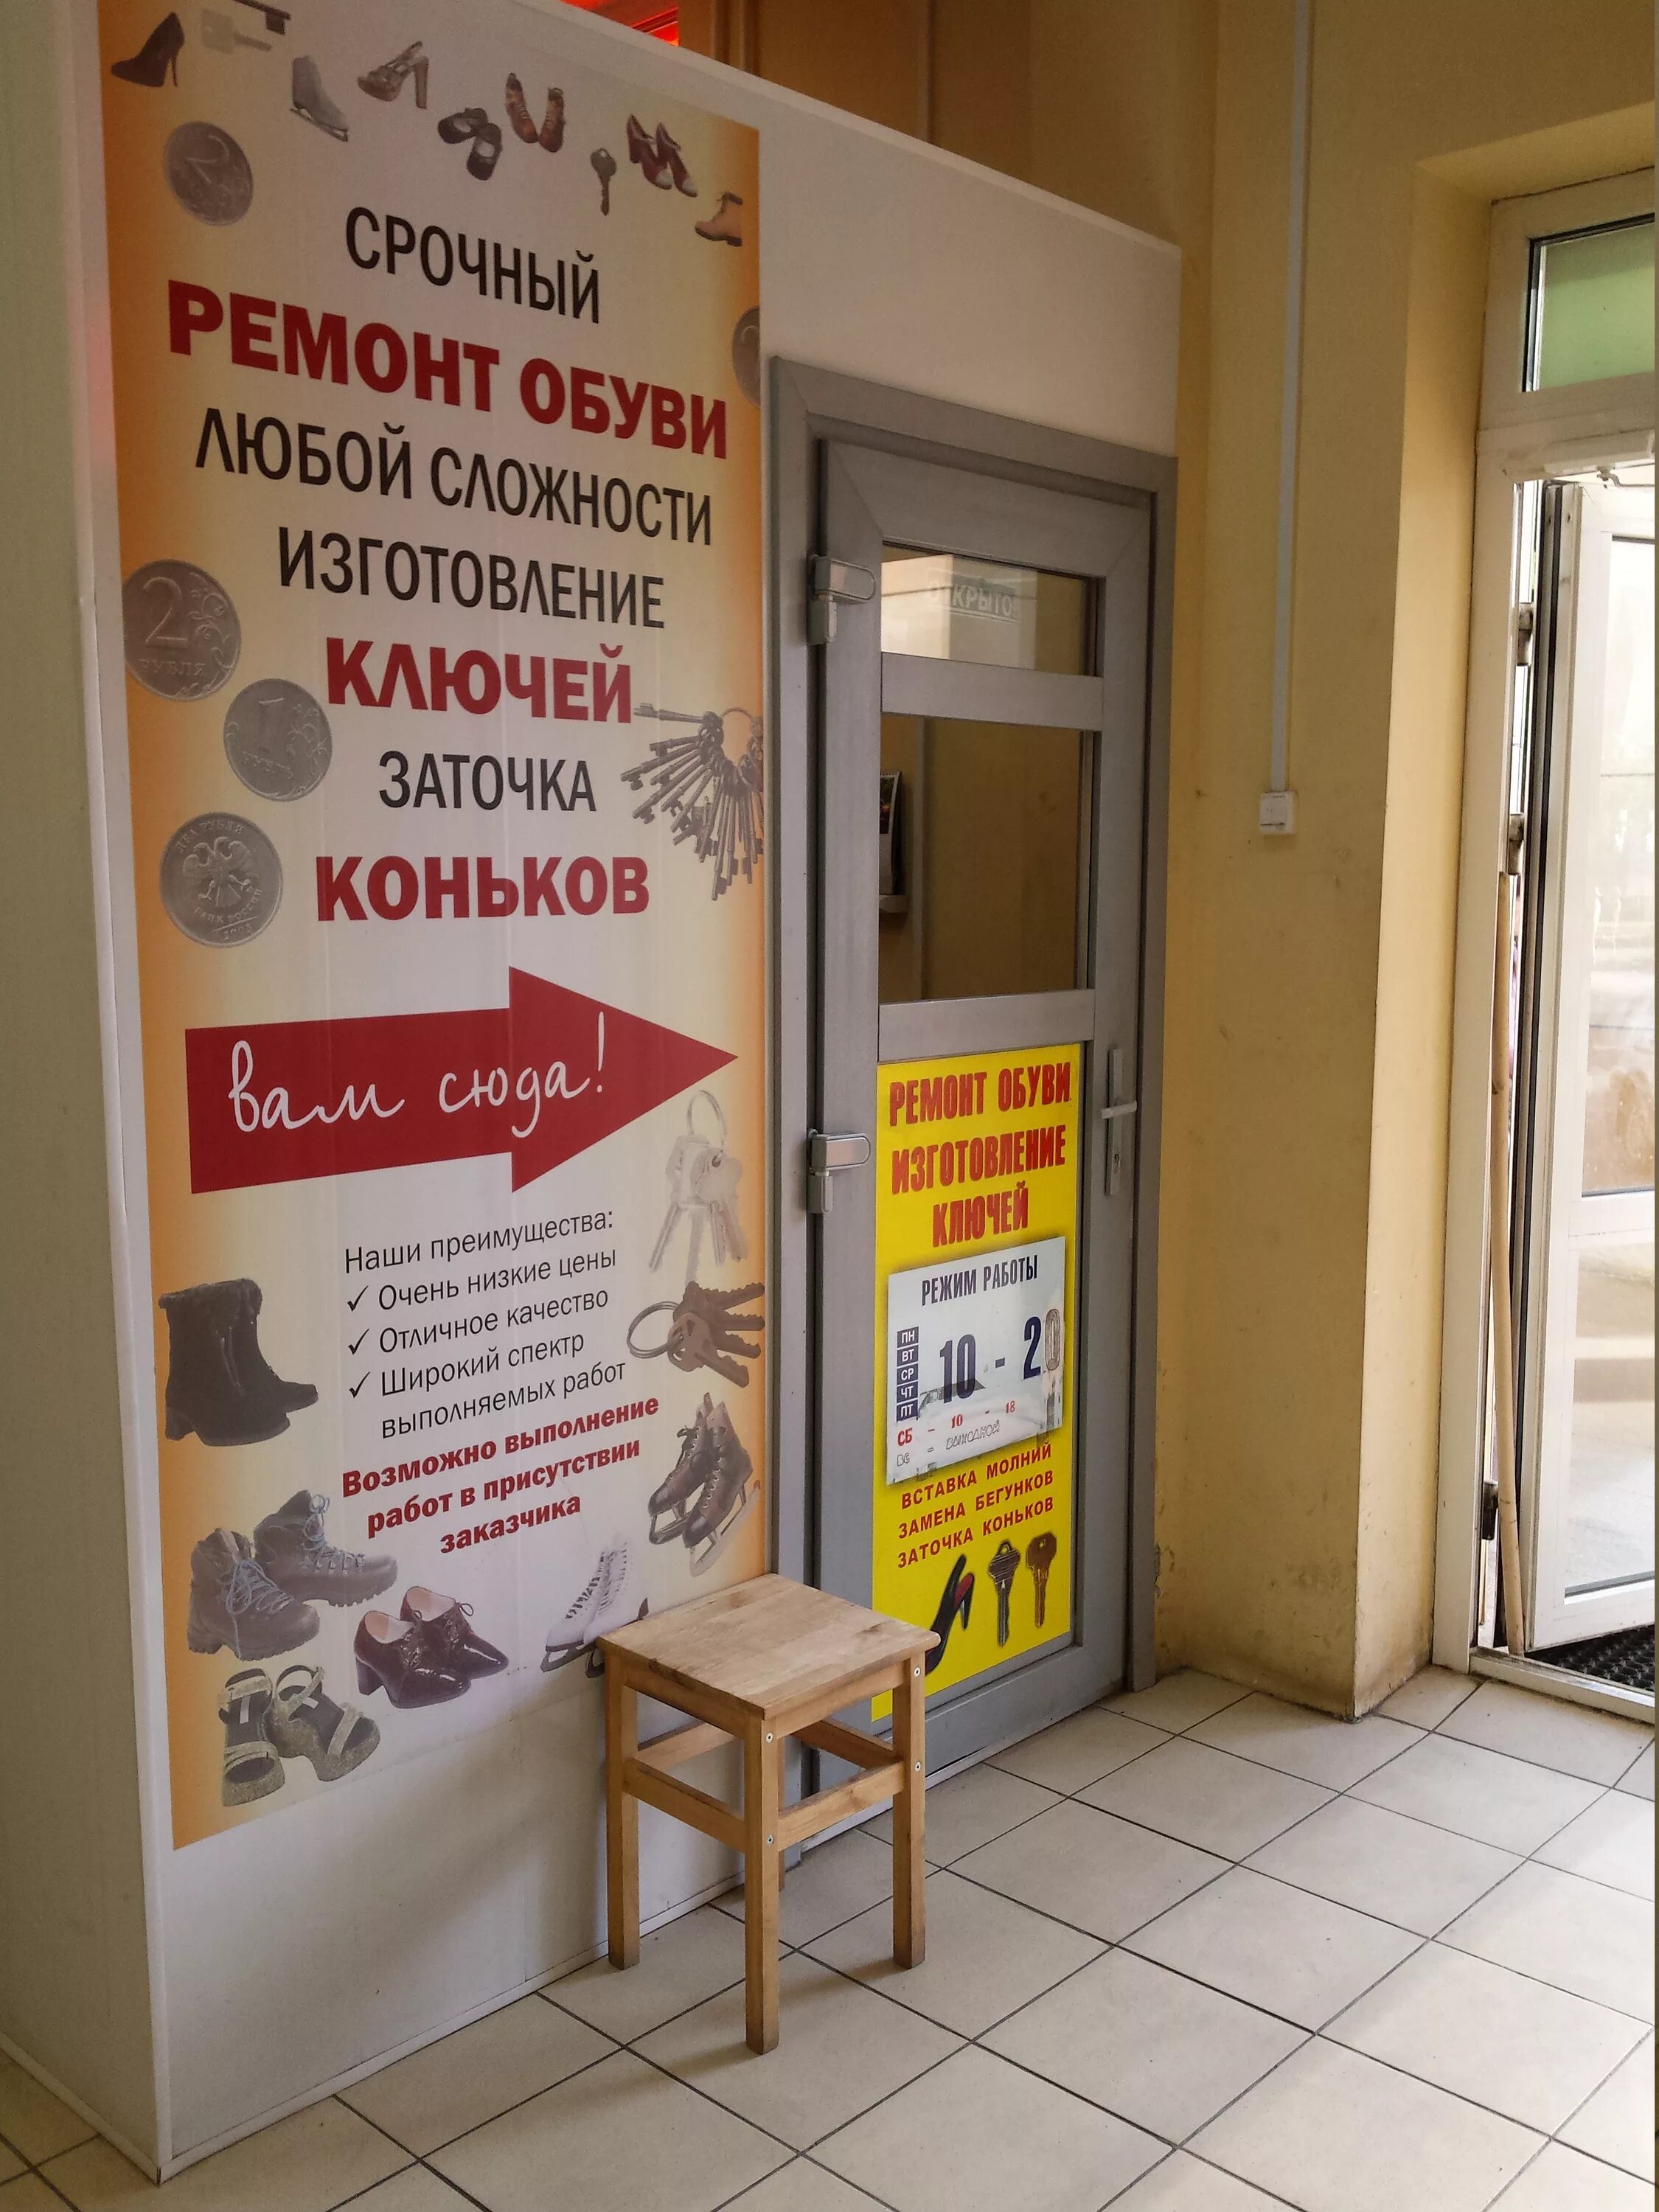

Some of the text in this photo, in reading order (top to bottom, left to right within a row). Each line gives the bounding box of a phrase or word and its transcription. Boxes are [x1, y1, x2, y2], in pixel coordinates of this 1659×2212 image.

[346, 206, 600, 324] СРОЧНЫЙ
[167, 279, 727, 460] РЕМОНТ ОБУВИ
[195, 407, 712, 546] ЛЮБОЙ СЛОЖНОСТИ
[279, 526, 664, 628] ИЗГОТОВЛЕНИЕ
[142, 577, 189, 648] 2
[326, 637, 632, 723] КЛЮЧЕЙ
[378, 750, 596, 812] ЗАТОЧКА
[316, 855, 650, 922] КОНЬКОВ
[229, 1012, 605, 1138] вам сюда!
[889, 1062, 1071, 1127] РЕМОНТ ОБУВИ
[892, 1125, 1065, 1194] ИЗГОТОВЛЕНИЕ
[346, 1209, 613, 1273] Наши преимущества:
[933, 1180, 1029, 1247] КЛЮЧЕЙ
[379, 1249, 616, 1310] Очень низкие цены
[922, 1255, 1037, 1306] РЕЖИМ РАБОТЫ
[380, 1289, 608, 1353] Отличное качество
[902, 1329, 915, 1343] ПН
[381, 1333, 585, 1399] Широкий спектр
[901, 1368, 914, 1381] СР
[902, 1349, 914, 1361] ВТ
[939, 1334, 976, 1403] 10
[1023, 1308, 1060, 1380] 20
[382, 1361, 625, 1439] выполняемых работ
[897, 1427, 913, 1446] СБ
[951, 1414, 963, 1428] 10
[1006, 1400, 1015, 1413] 18
[901, 1386, 914, 1398] ЧТ
[901, 1404, 913, 1417] ПТ
[342, 1397, 659, 1498] Возможно выполнение
[897, 1453, 910, 1467] ВС
[902, 1441, 1051, 1510] ВСТАВКА МОЛНИЙ
[368, 1440, 639, 1539] работ в присутствии
[898, 1470, 1054, 1540] ЗАМЕНА БЕГУНКОВ
[440, 1495, 581, 1554] заказчика
[897, 1496, 1054, 1569] ЗАТОЧКА КОНЬКОВ
